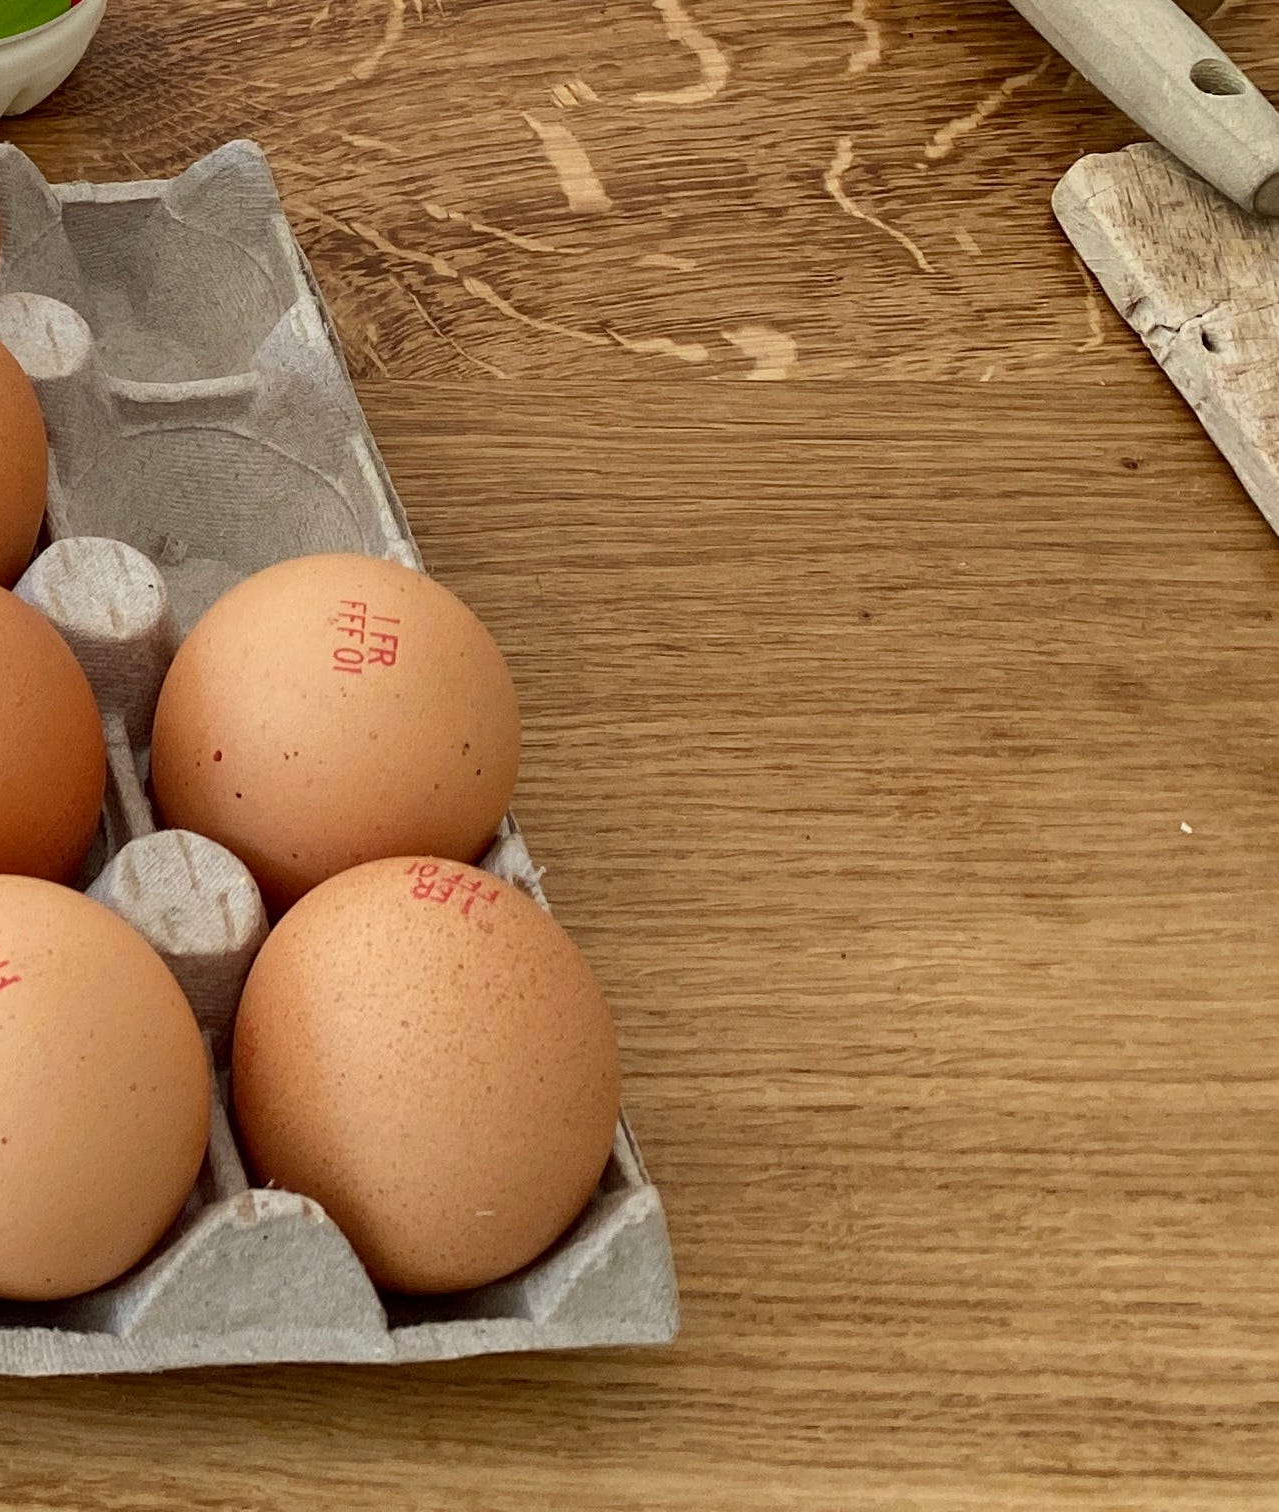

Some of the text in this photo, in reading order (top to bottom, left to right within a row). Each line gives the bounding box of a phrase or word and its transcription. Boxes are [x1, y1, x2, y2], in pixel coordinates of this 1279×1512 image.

[337, 600, 366, 644] FFF
[368, 632, 398, 666] FR
[413, 877, 453, 903] FR
[442, 874, 499, 903] FFF
